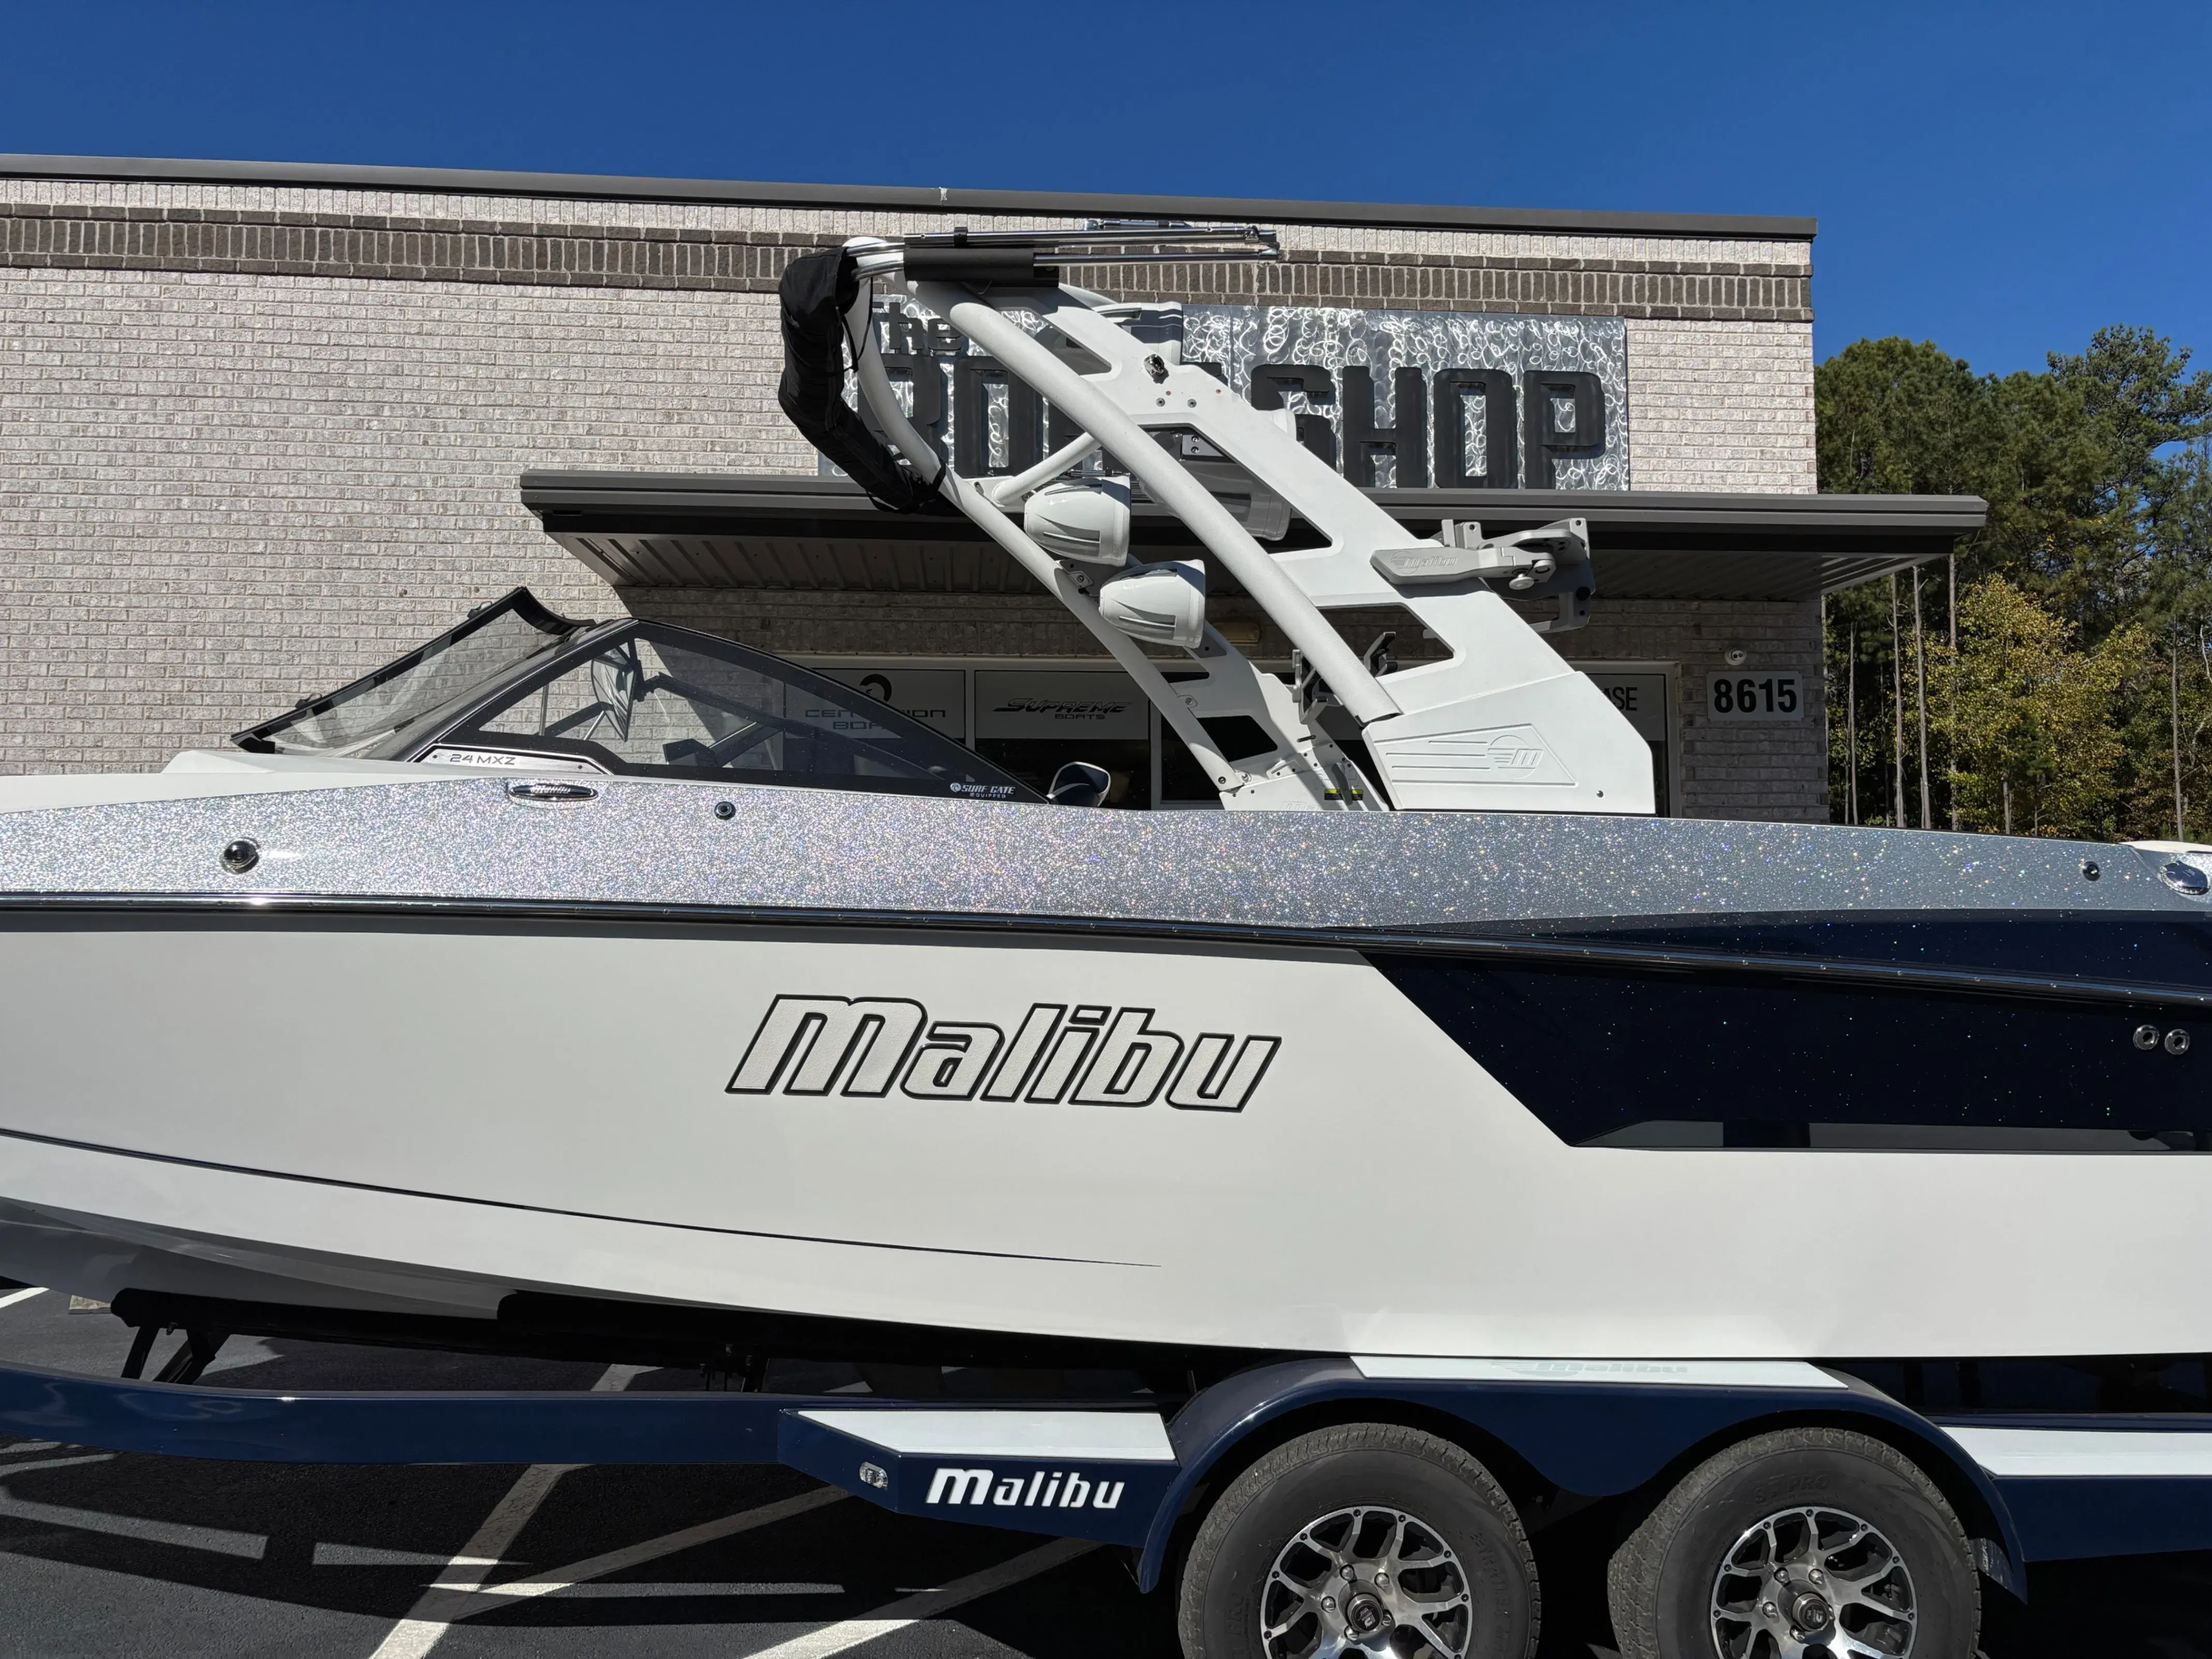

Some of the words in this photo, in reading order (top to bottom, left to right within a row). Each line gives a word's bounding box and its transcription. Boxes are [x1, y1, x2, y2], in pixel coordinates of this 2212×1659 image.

[872, 301, 962, 351] he
[1251, 363, 1606, 488] SHOP
[992, 698, 1132, 714] SUPREME
[1714, 678, 1797, 714] 8615
[449, 753, 473, 763] 24
[477, 754, 516, 765] MXZ
[961, 784, 988, 793] SURF
[989, 786, 1016, 794] GATE
[724, 994, 1282, 1113] Malibu
[925, 1468, 1125, 1509] Malibu
